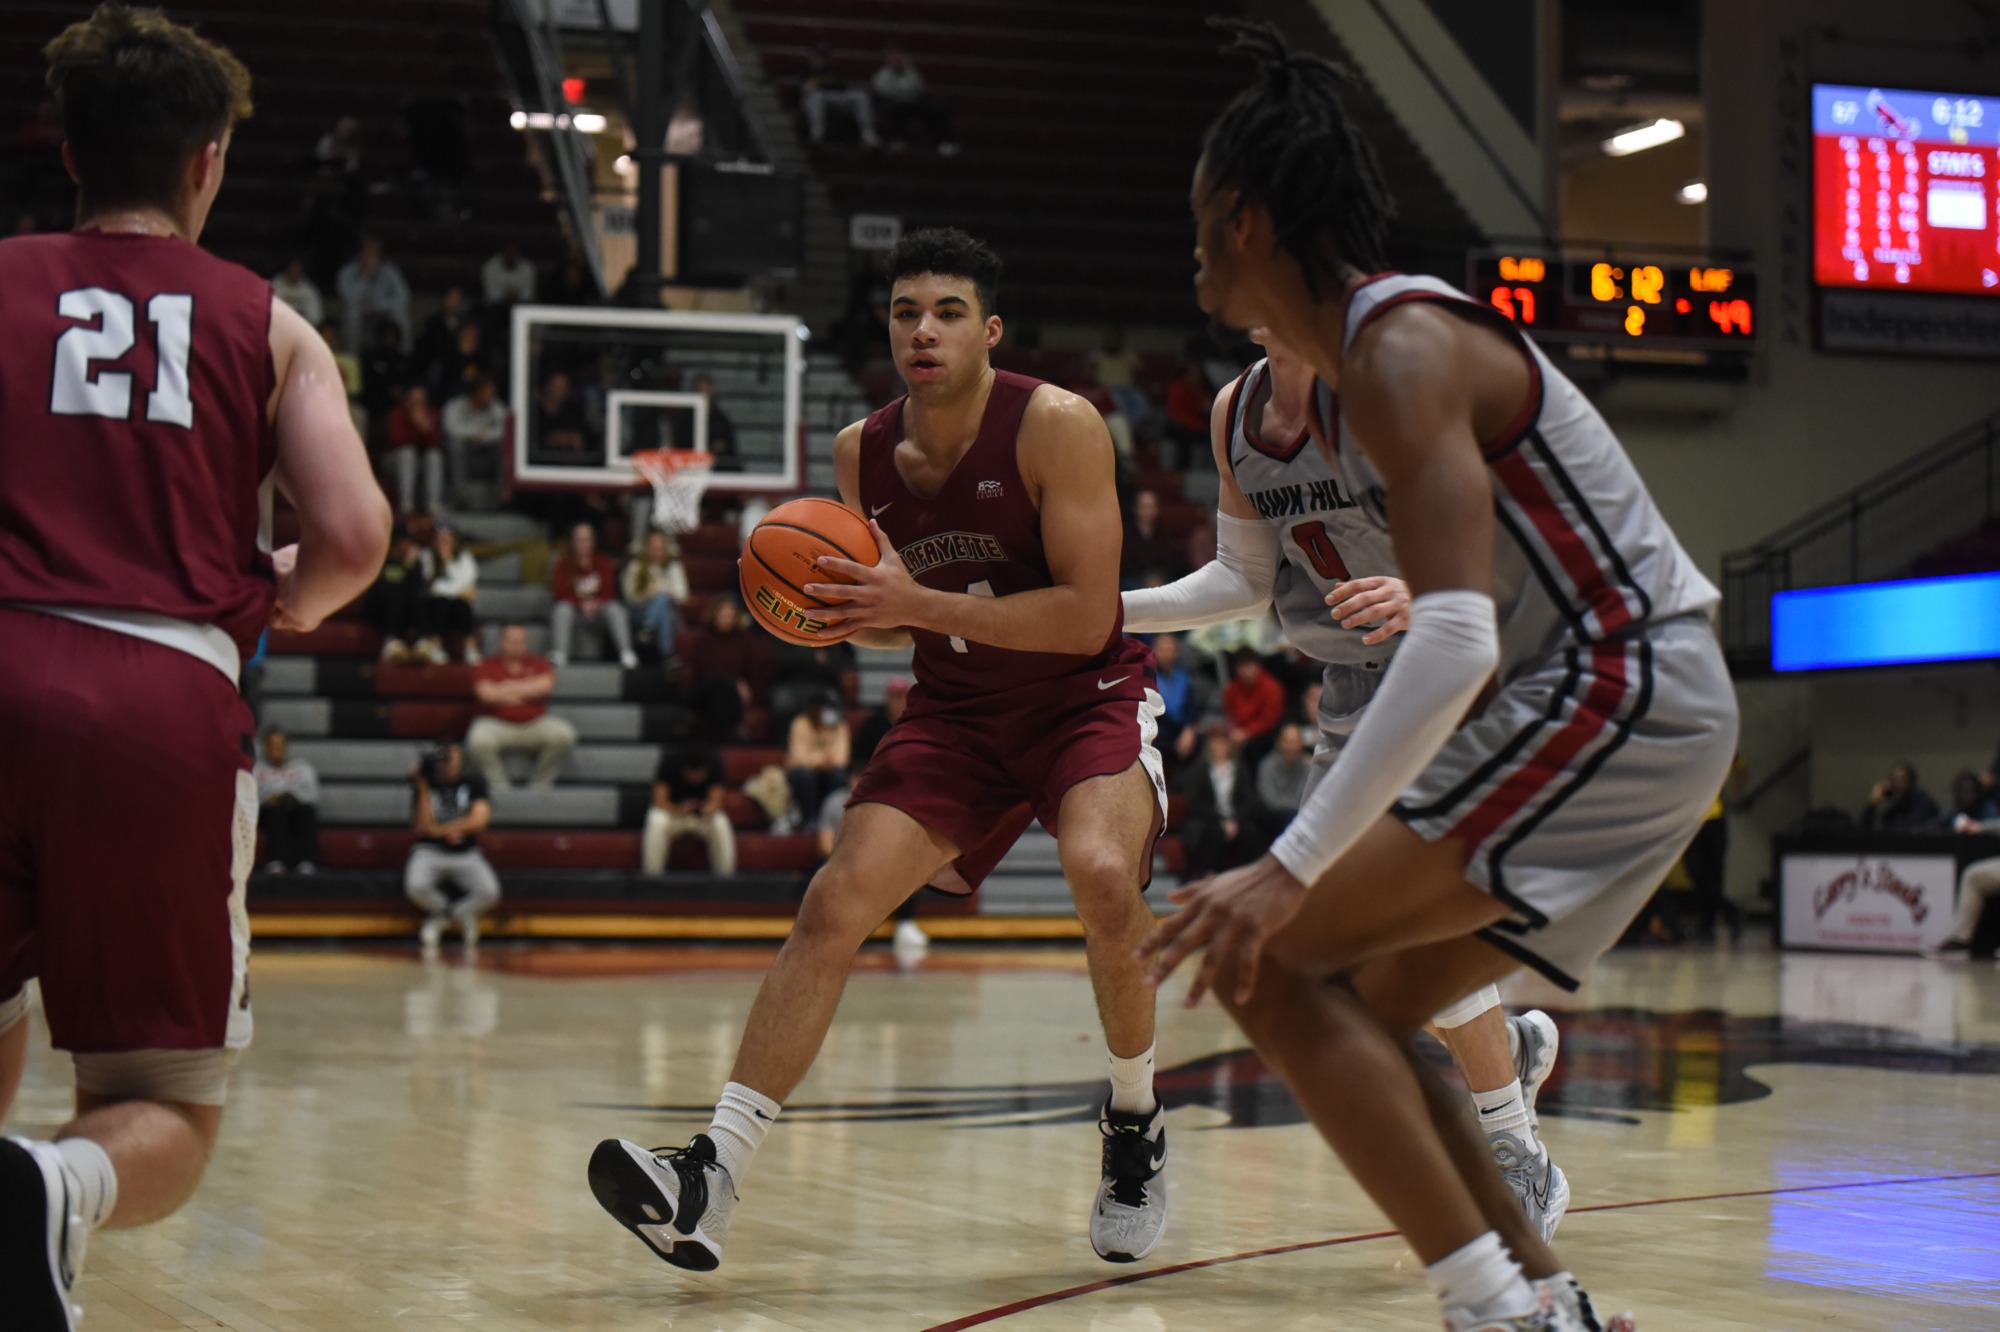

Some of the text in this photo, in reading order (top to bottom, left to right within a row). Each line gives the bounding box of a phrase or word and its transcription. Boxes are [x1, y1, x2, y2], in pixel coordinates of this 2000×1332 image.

[1709, 299, 1751, 335] 49
[50, 285, 195, 431] 21
[1291, 520, 1352, 581] 0
[755, 585, 829, 635] ELITE
